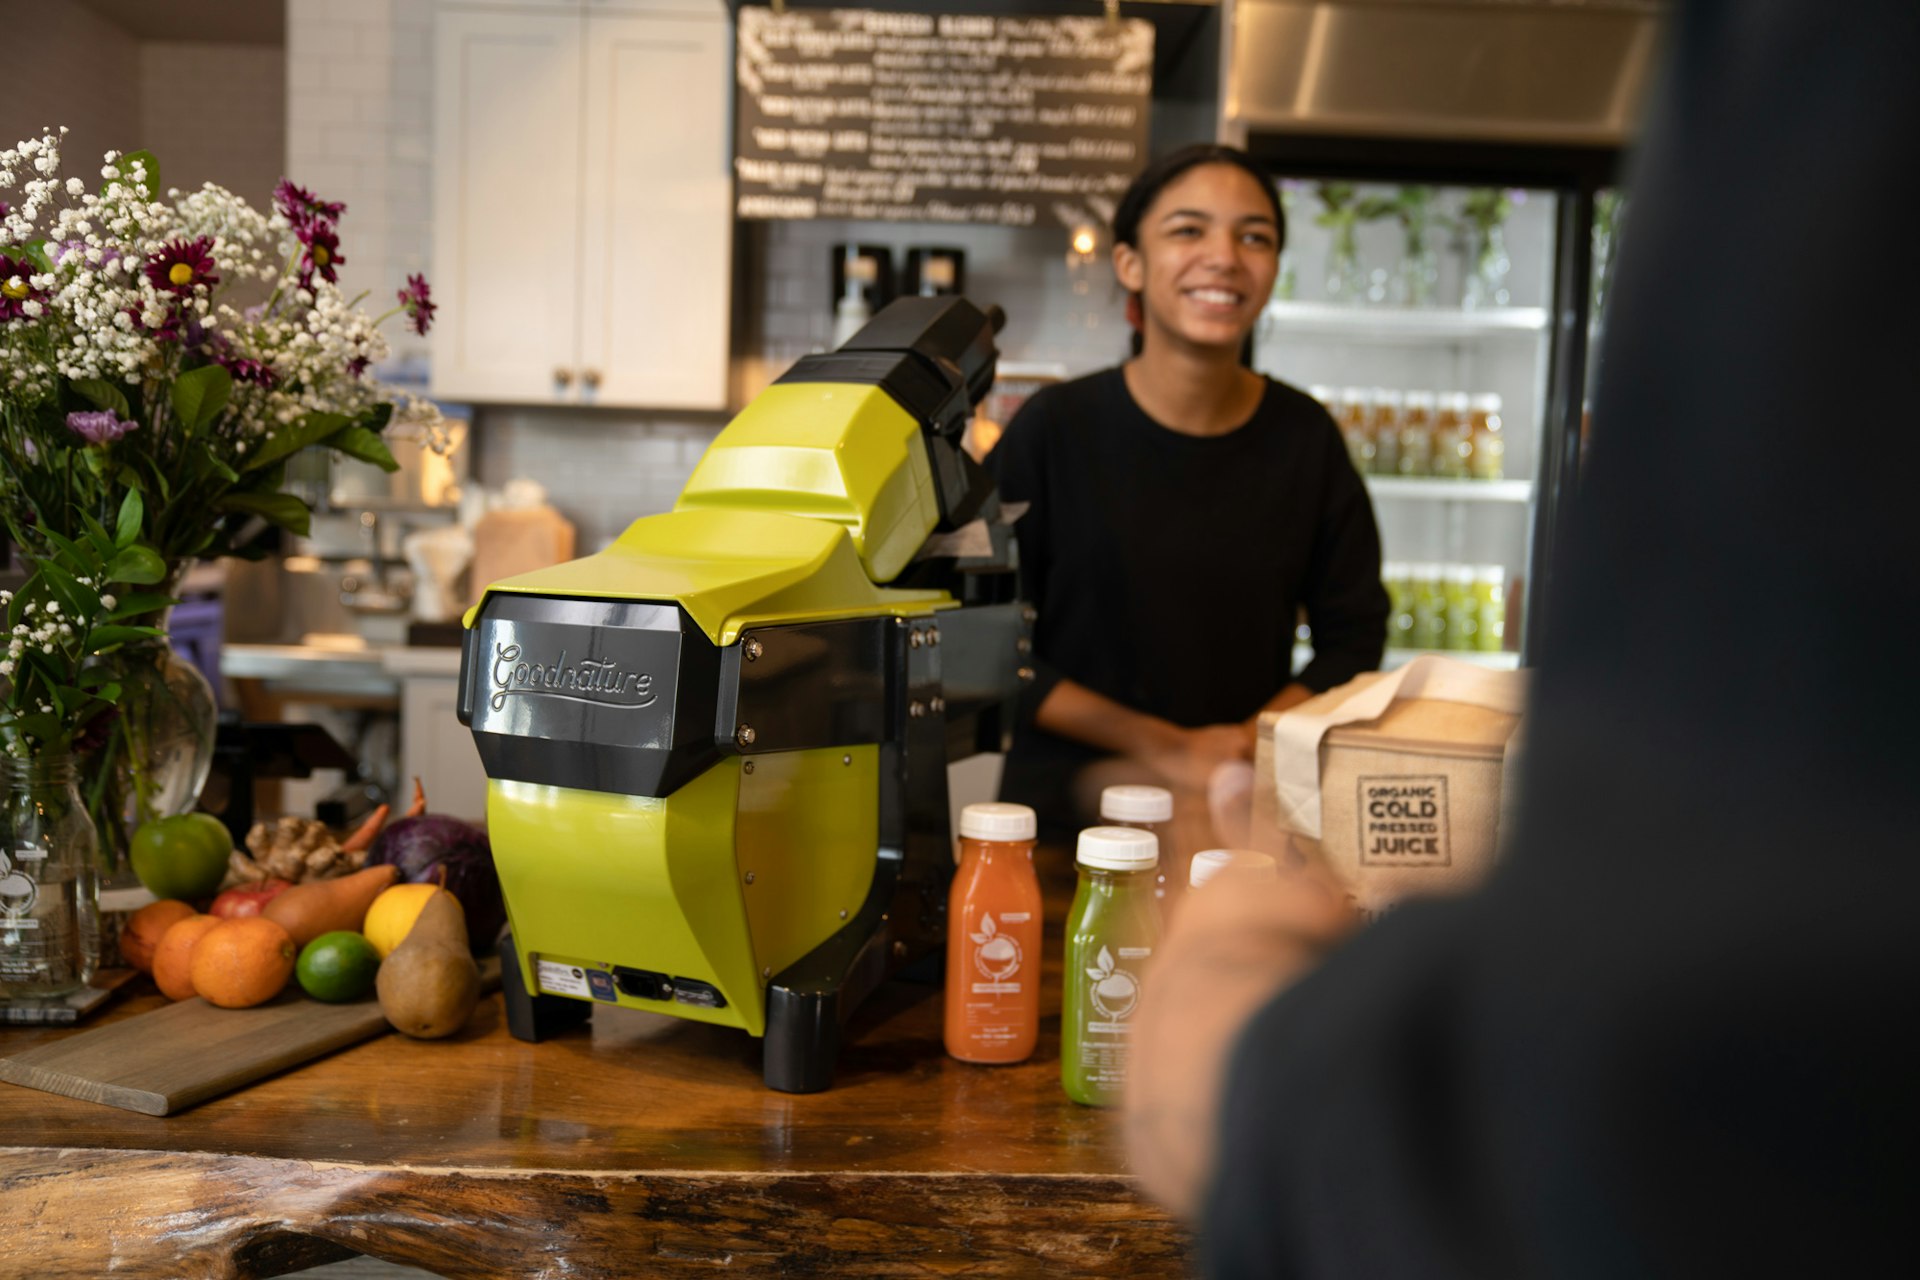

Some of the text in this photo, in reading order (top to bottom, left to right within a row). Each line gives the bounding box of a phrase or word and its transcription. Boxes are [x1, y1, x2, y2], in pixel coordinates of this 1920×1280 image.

[491, 642, 656, 712] Goodnature
[1368, 786, 1435, 798] ORGANIC
[1369, 800, 1437, 818] COLD
[1369, 822, 1438, 834] PRESSED
[1371, 837, 1439, 855] JUICE
